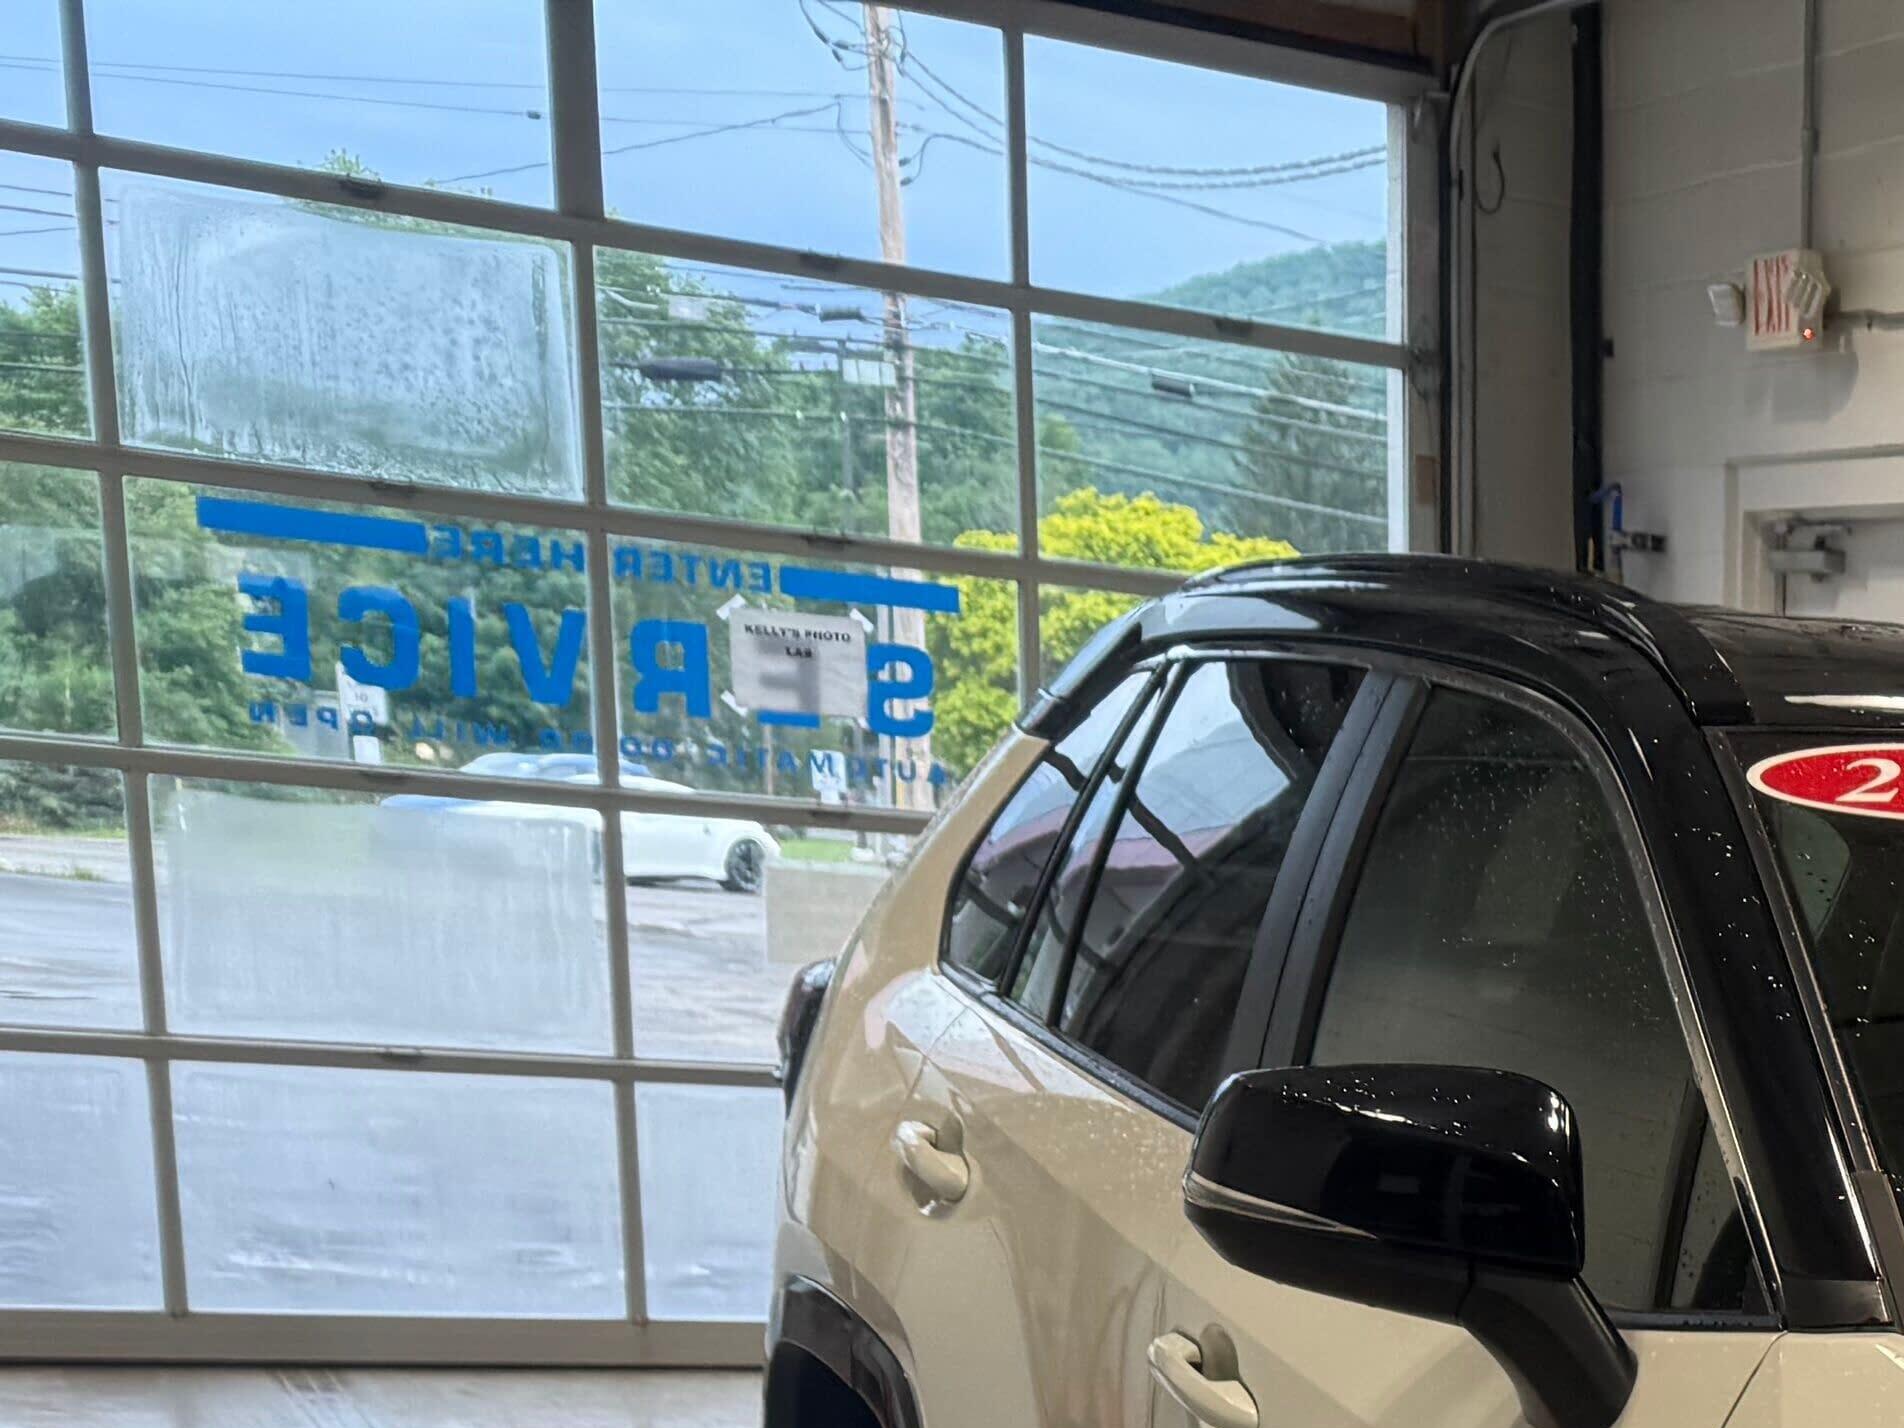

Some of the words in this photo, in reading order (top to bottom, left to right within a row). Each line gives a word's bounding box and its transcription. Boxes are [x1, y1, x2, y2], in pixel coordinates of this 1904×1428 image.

[744, 623, 800, 638] KELLY'S
[804, 629, 851, 643] PHOTO
[785, 646, 813, 658] LAB
